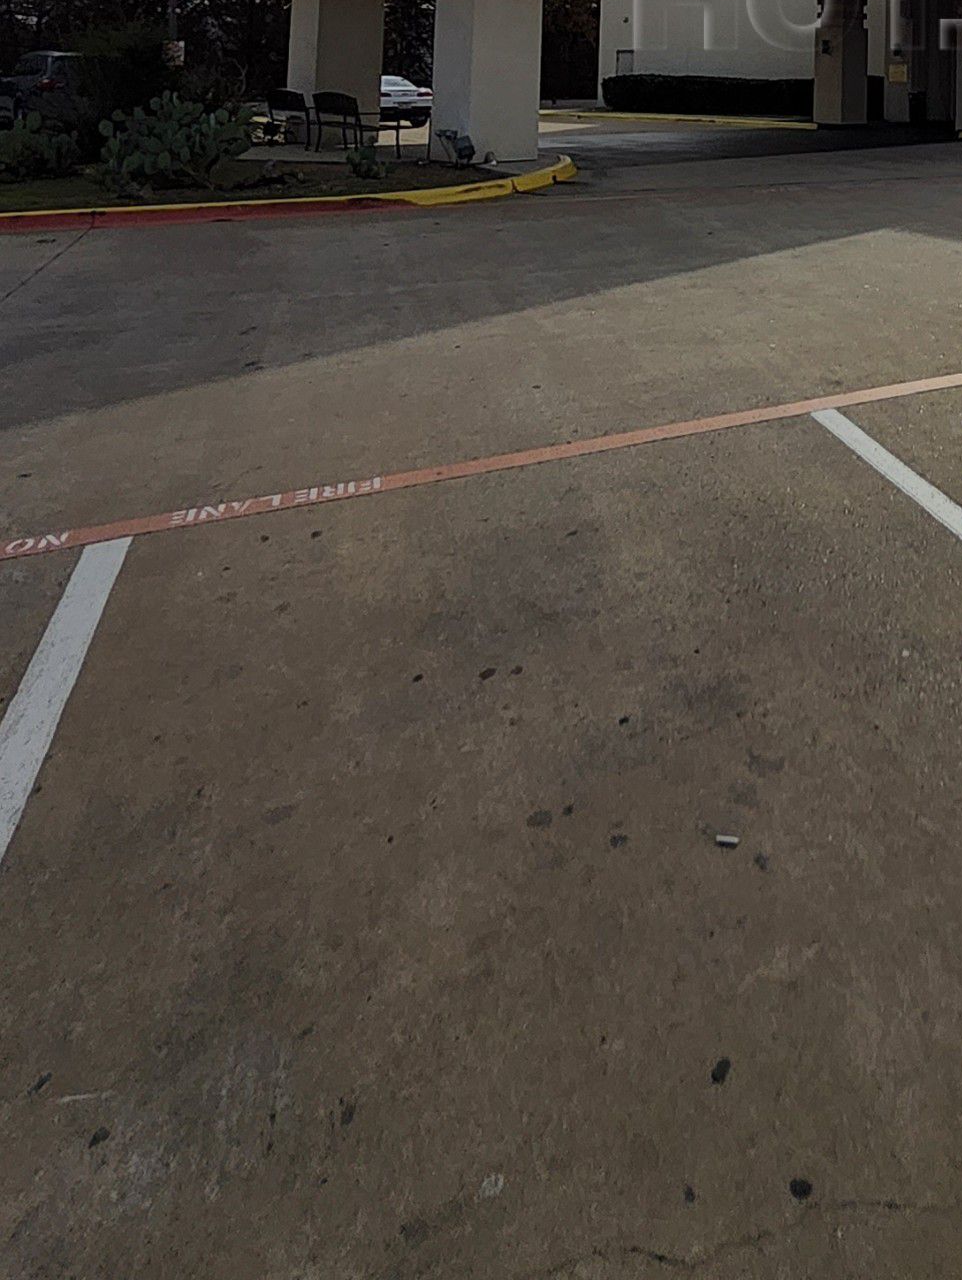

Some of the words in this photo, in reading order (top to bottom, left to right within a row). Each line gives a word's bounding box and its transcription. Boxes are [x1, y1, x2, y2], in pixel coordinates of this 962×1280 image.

[295, 476, 382, 503] FIRE
[170, 493, 282, 525] LANE
[5, 531, 69, 554] NO
